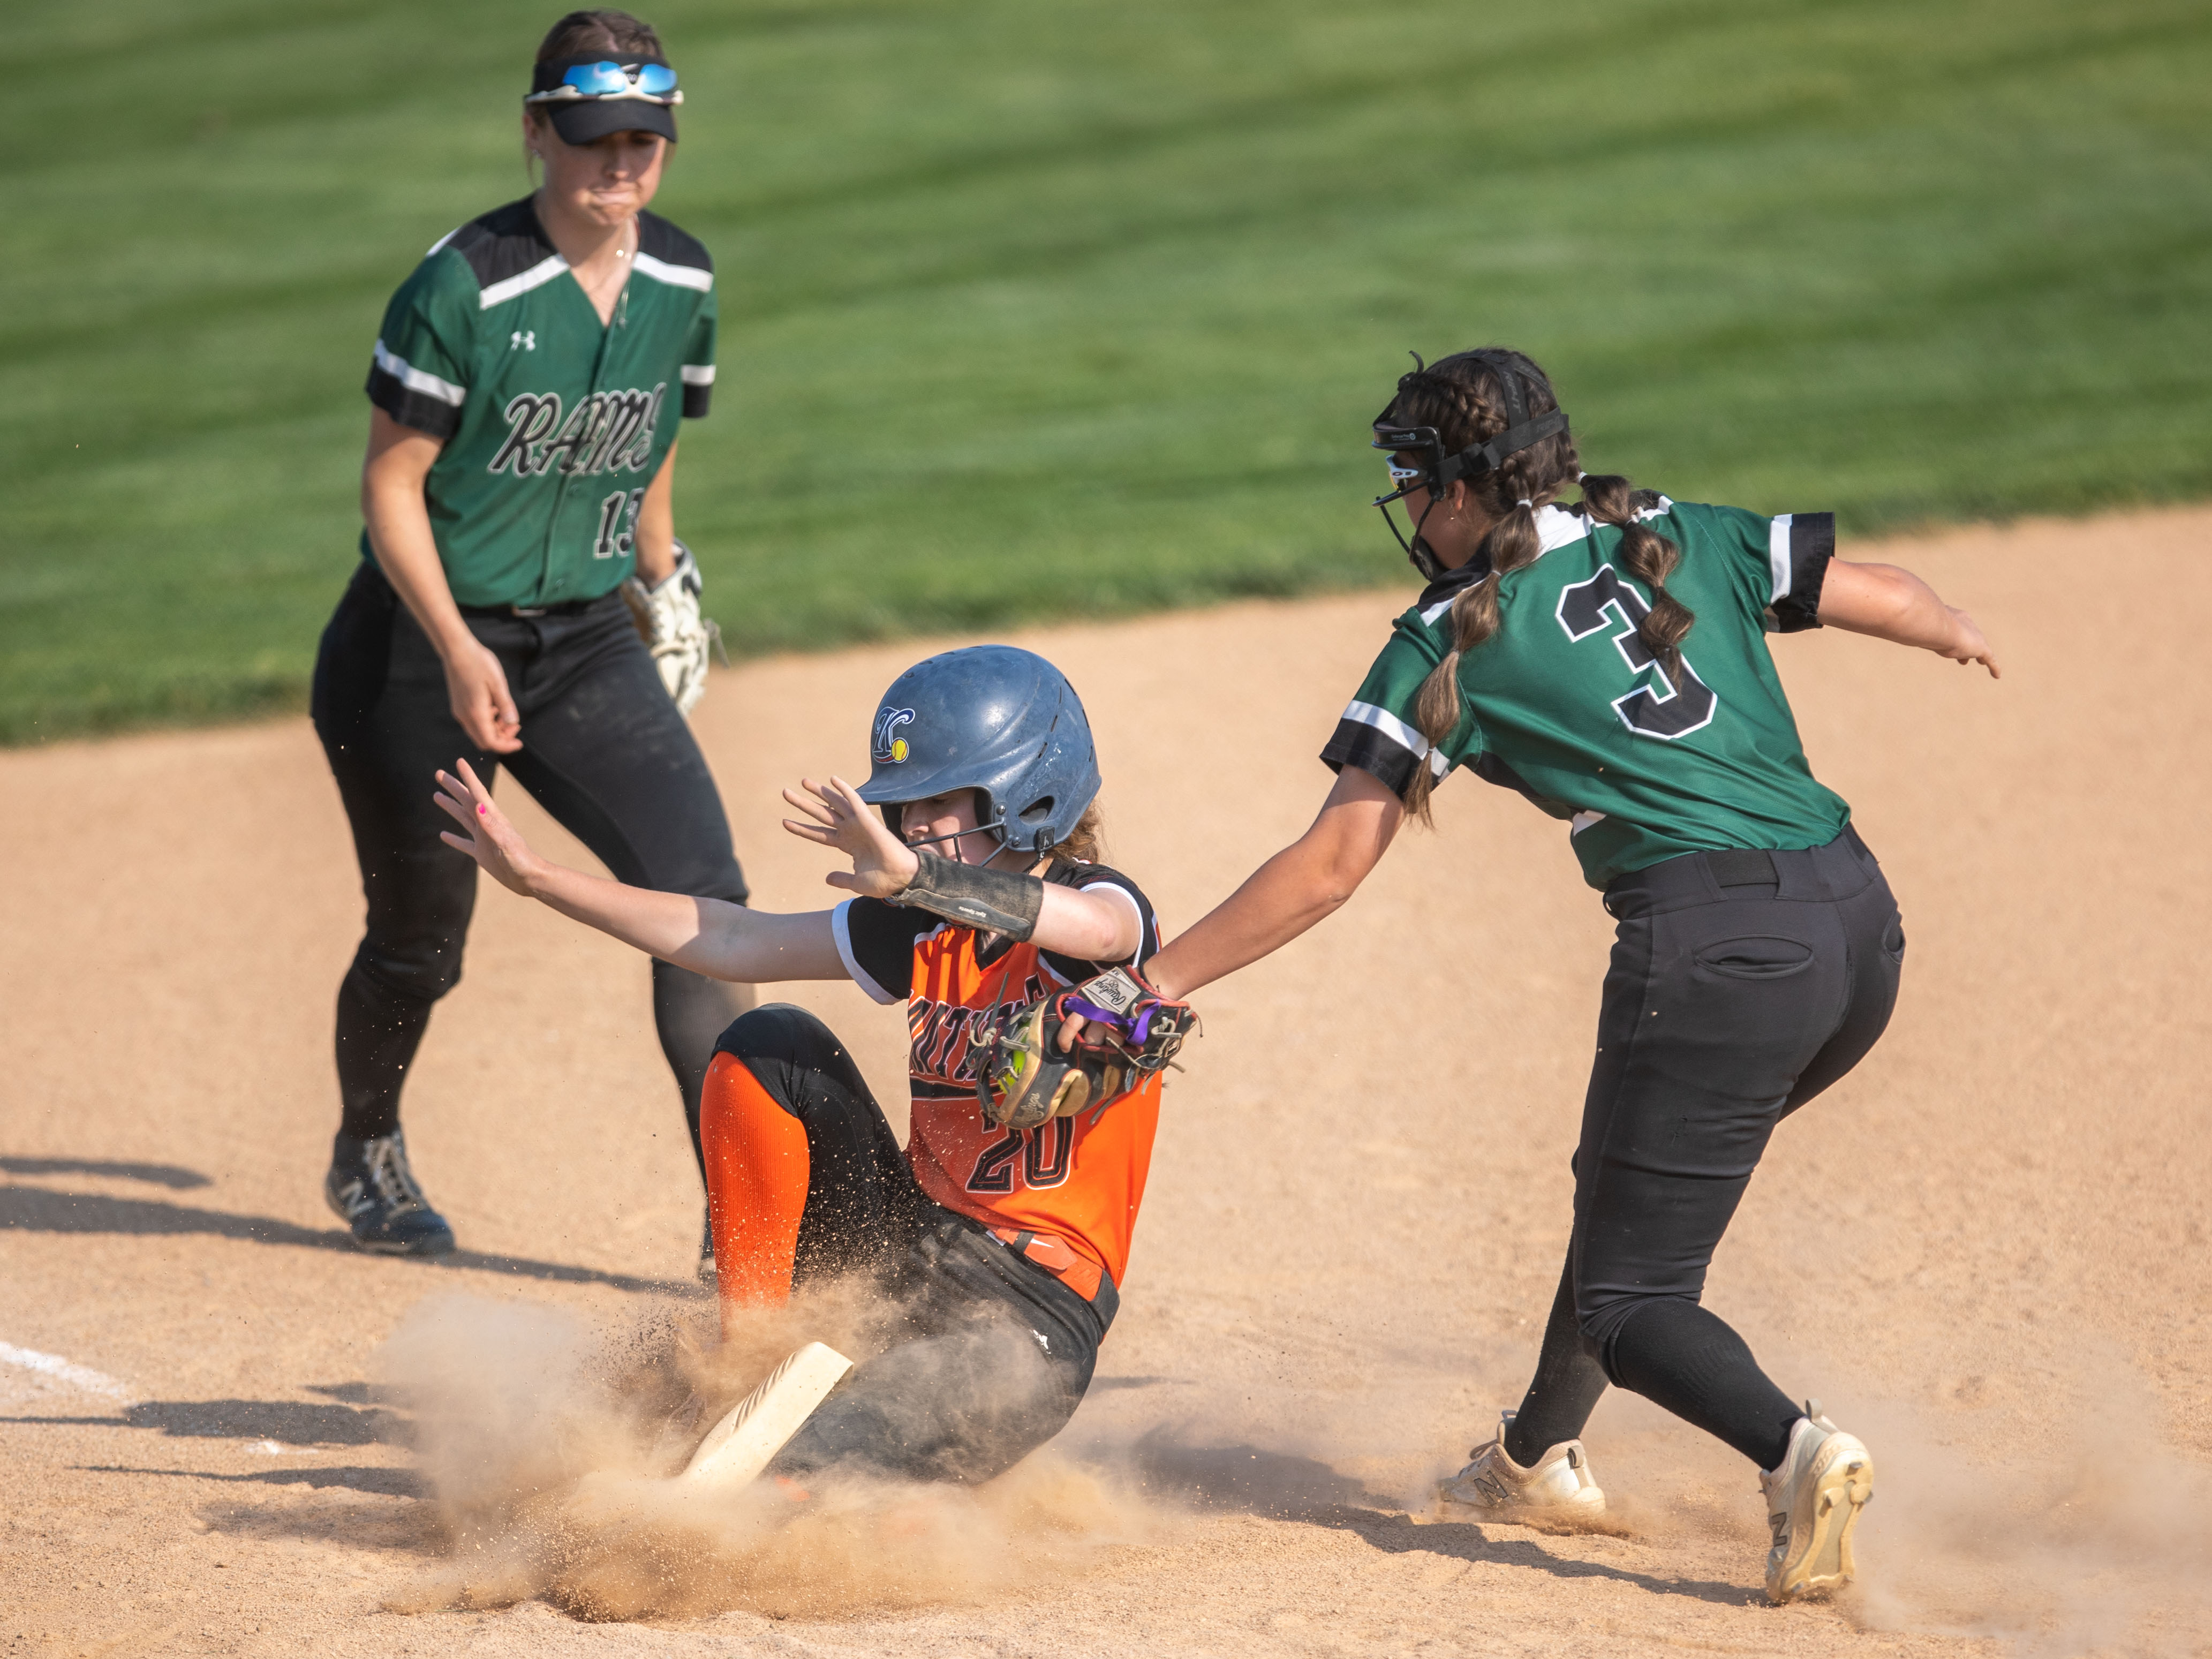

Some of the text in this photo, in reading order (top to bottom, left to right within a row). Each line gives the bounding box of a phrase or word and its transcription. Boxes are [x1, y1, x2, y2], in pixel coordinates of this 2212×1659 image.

[1555, 563, 1718, 740] 3
[1094, 978, 1126, 1005] Rawlings
[965, 1110, 1076, 1194] 20
